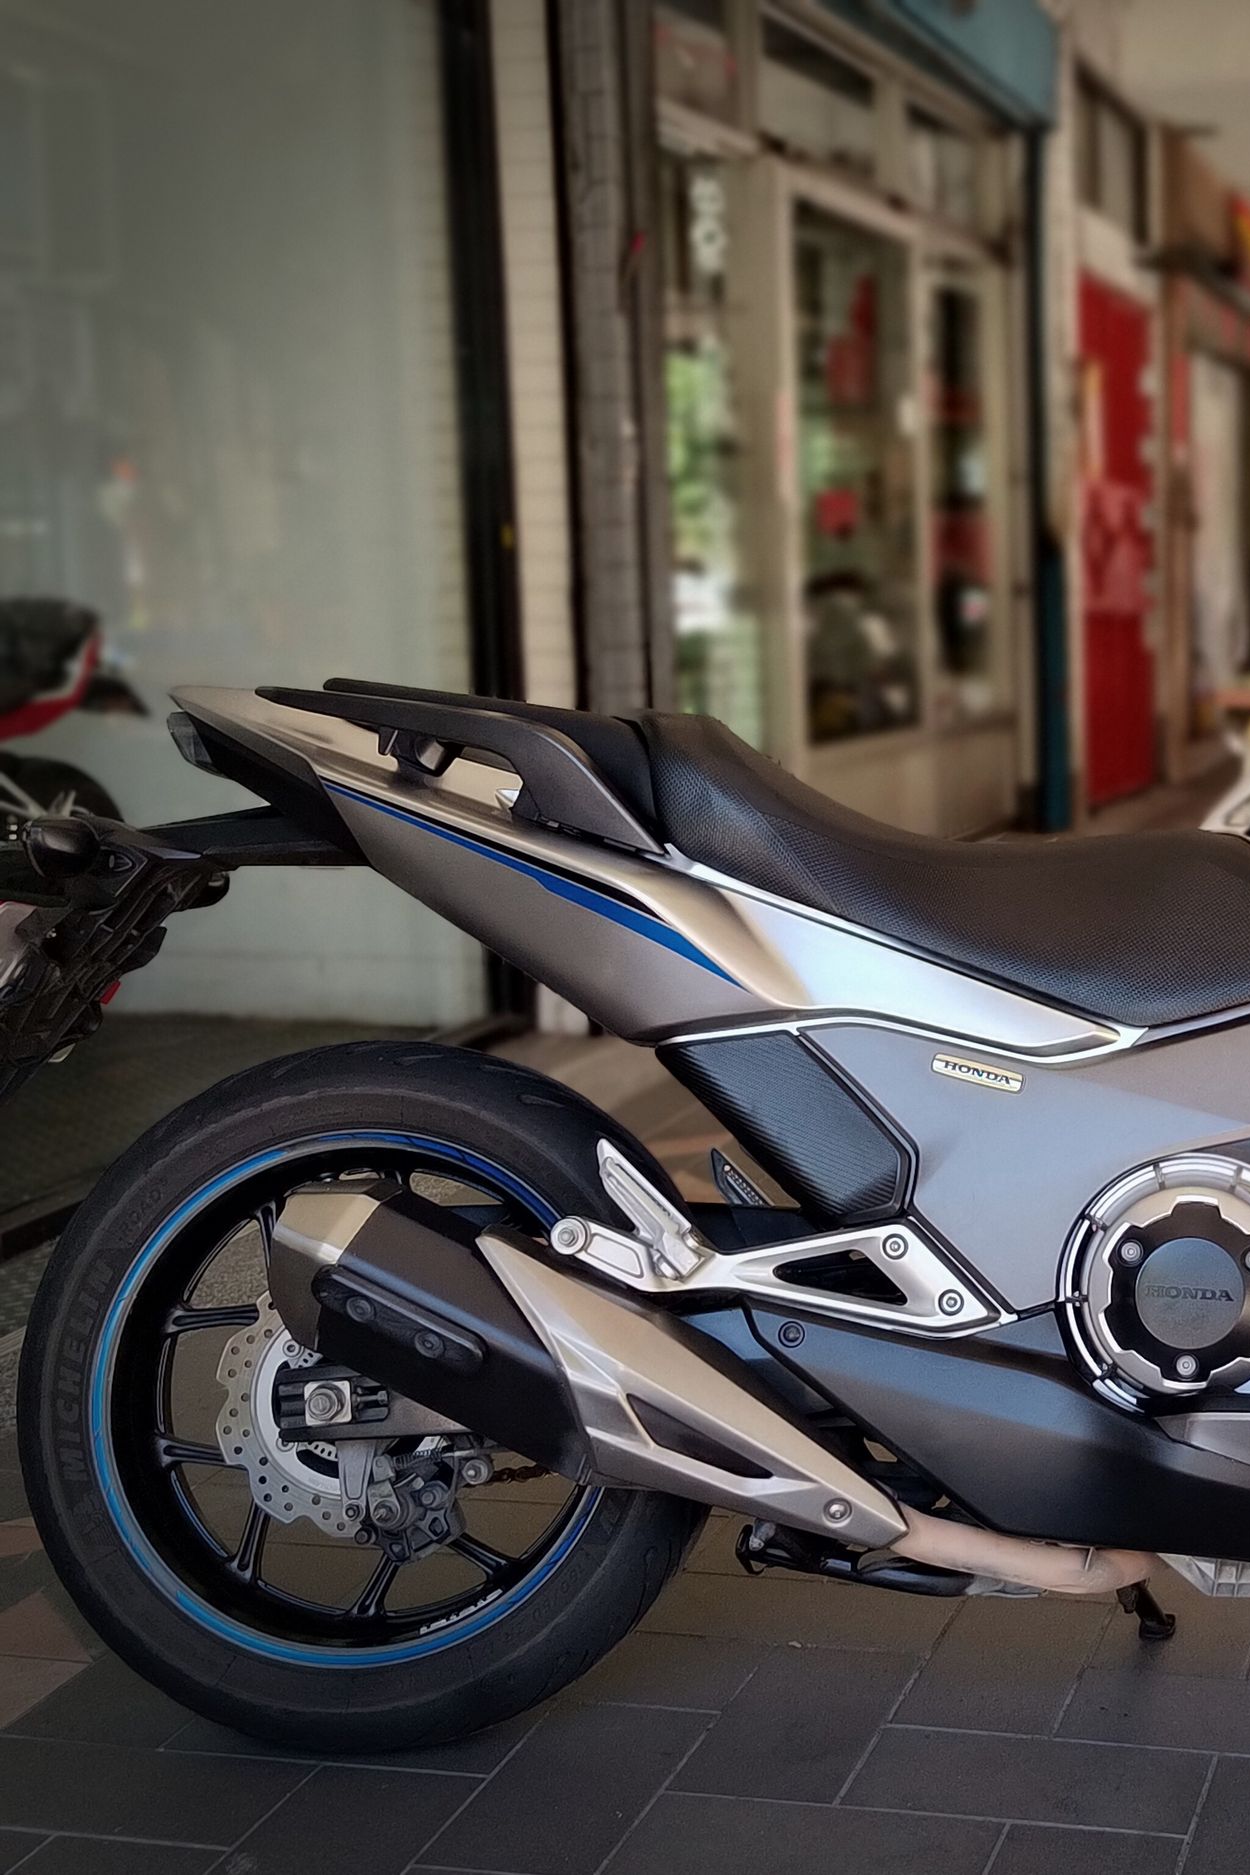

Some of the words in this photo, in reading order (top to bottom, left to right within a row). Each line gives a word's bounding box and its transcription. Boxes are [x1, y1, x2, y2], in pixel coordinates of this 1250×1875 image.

[943, 1059, 1012, 1086] HONDA
[1144, 1285, 1235, 1302] HONDA
[57, 1261, 115, 1483] MICHELIN
